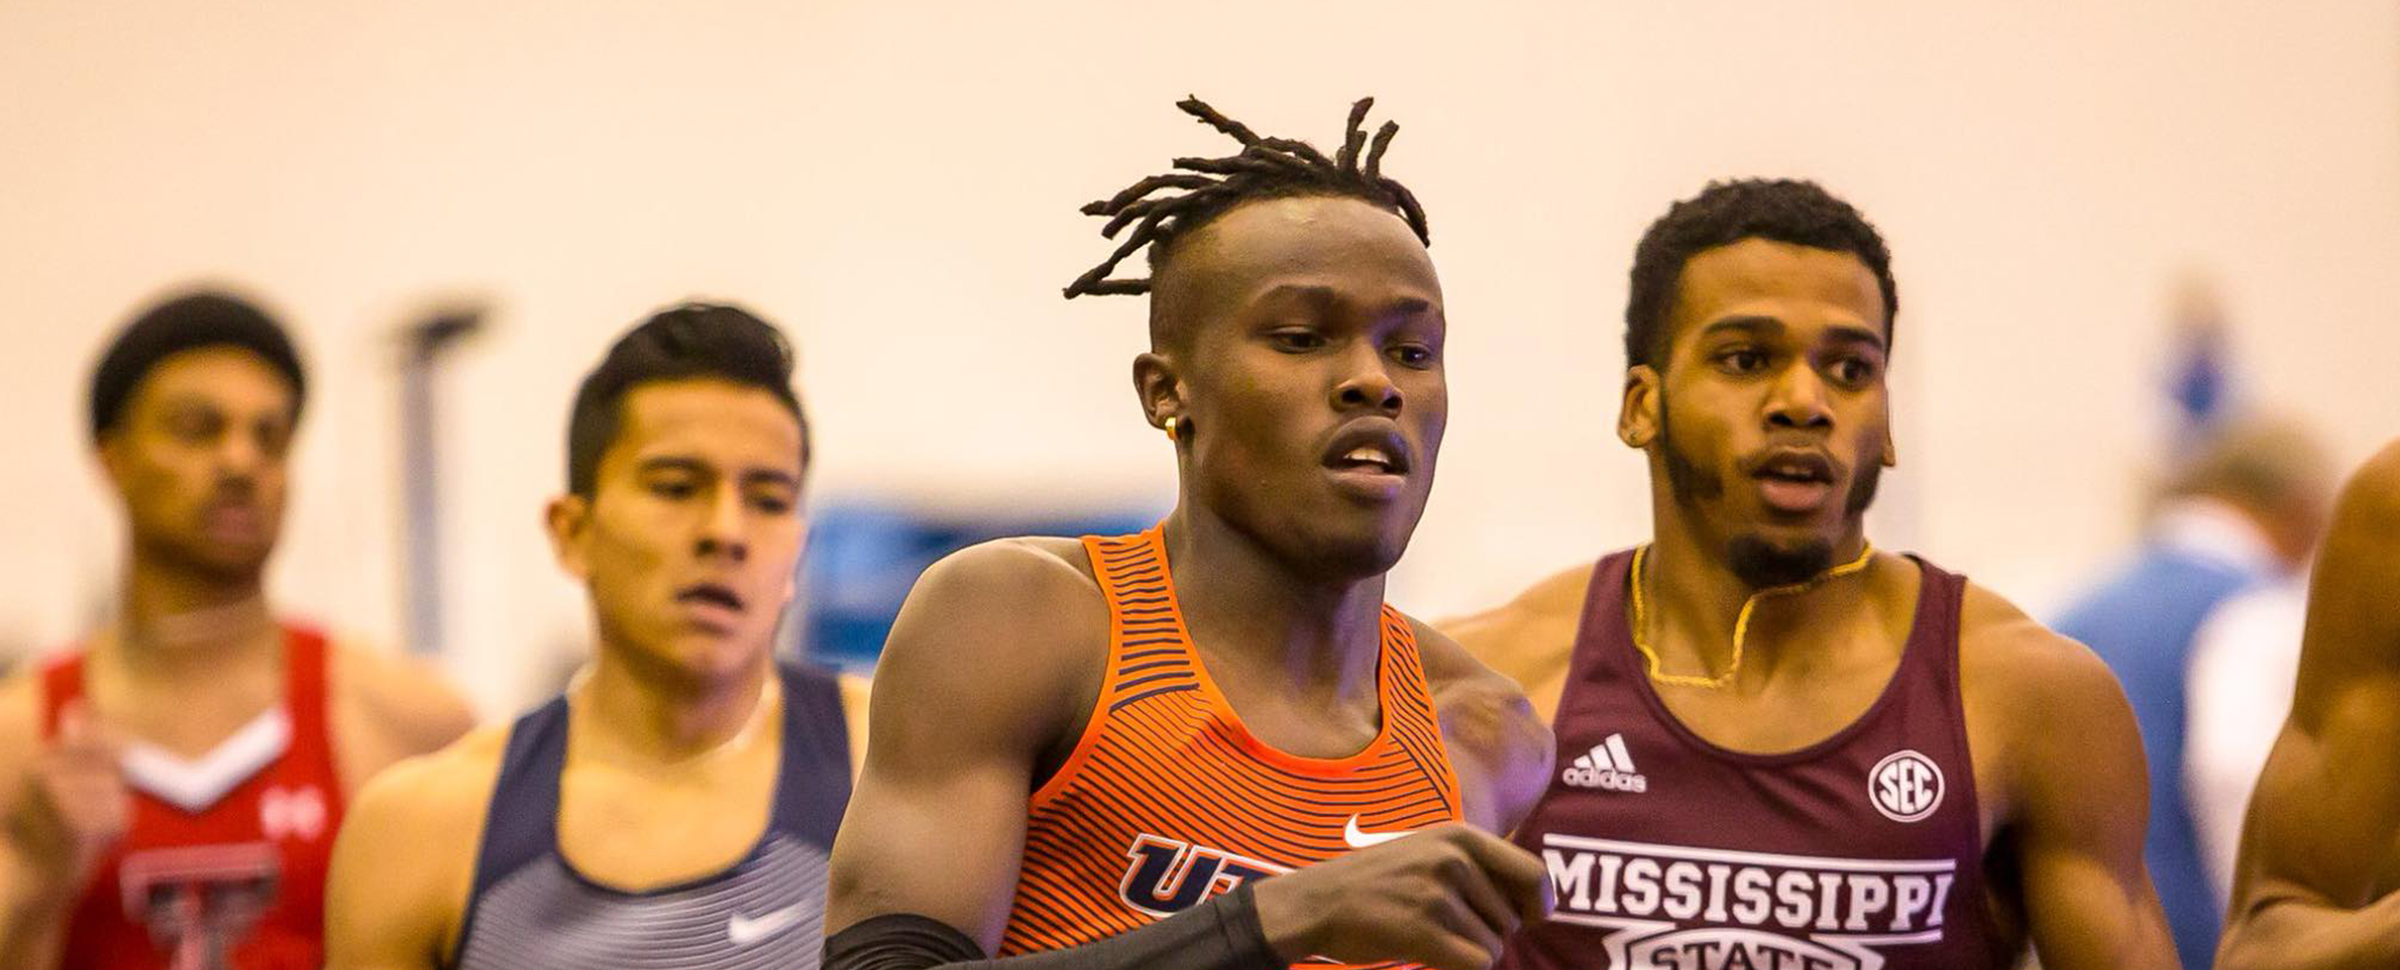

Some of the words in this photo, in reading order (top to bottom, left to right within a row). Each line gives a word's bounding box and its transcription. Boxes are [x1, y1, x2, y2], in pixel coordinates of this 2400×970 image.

[1563, 767, 1646, 793] adidas
[1879, 759, 1933, 814] SEC
[1542, 848, 1954, 931] MISSISSIPPI
